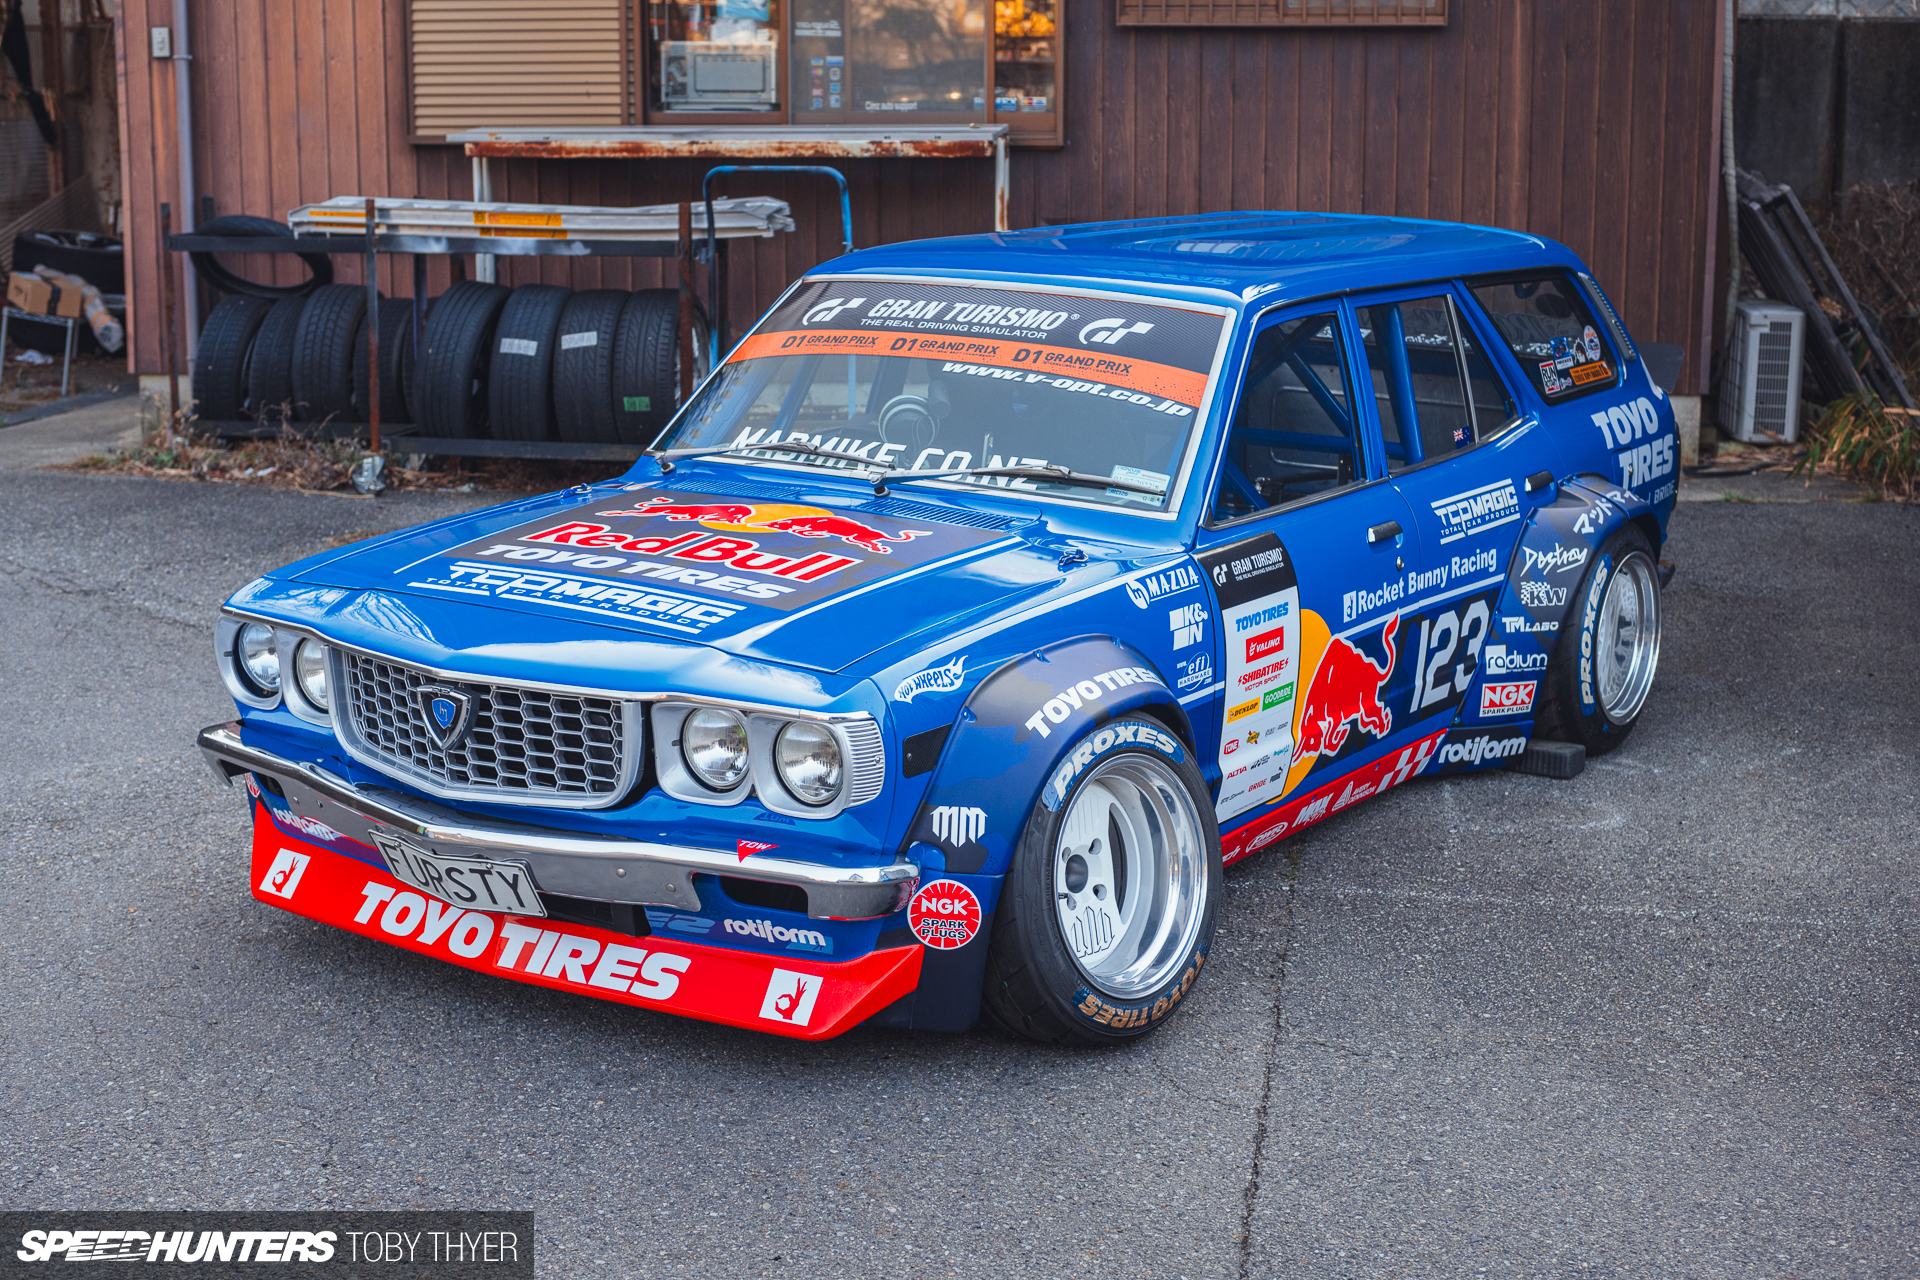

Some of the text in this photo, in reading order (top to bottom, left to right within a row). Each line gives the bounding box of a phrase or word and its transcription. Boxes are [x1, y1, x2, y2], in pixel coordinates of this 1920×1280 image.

[895, 102, 918, 112] support
[860, 318, 1047, 340] THE REAL DRIVING SIMULATOR
[868, 299, 1068, 331] GRAN TURISMO
[781, 335, 880, 348] D1 GRAND PRIX
[890, 337, 1000, 355] D1 GRAND PRIX
[1011, 348, 1133, 374] D1 GRAND PRIX
[941, 362, 1193, 418] www.v-opt.co.jp
[1591, 396, 1659, 450] TOYO
[1618, 433, 1674, 490] TIRES
[1440, 505, 1520, 536] TOTAL CAR PRODUCE
[523, 521, 864, 583] Red Bull
[1231, 547, 1283, 576] GRAN TURISMO
[475, 544, 797, 600] TOYO TIRES
[1145, 565, 1199, 597] MAZDA
[1358, 549, 1497, 614] Rocket Bunny Racing
[425, 577, 711, 630] TOTAL CAR PRODUCE
[1527, 587, 1567, 607] KW
[1236, 602, 1289, 633] TOYO TIRES
[1580, 559, 1608, 705] PROXES
[1188, 655, 1206, 675] efi
[1410, 599, 1490, 713] 123
[1487, 650, 1548, 669] radium
[1179, 669, 1211, 686] HARDWARE
[1242, 660, 1284, 685] SHIBATIRE
[1244, 673, 1281, 692] MOTOR SPORT
[898, 681, 914, 700] HOT
[1264, 686, 1292, 704] GOODRIDE
[1484, 684, 1534, 707] NGK
[1025, 680, 1103, 739] TOYO
[1234, 702, 1259, 717] DUNLOP
[1481, 705, 1530, 716] SPARK PLUGS
[1052, 725, 1179, 802] PROXES
[1438, 735, 1527, 765] rotiform
[738, 840, 772, 850] TOW
[379, 840, 526, 909] FURSTY
[921, 897, 969, 916] NGK
[723, 918, 827, 947] rotiform
[921, 918, 966, 929] SPARK
[921, 928, 966, 940] PLUGS
[354, 880, 692, 1001] TOYO TIRES
[1078, 951, 1206, 1029] TOYO TIRES
